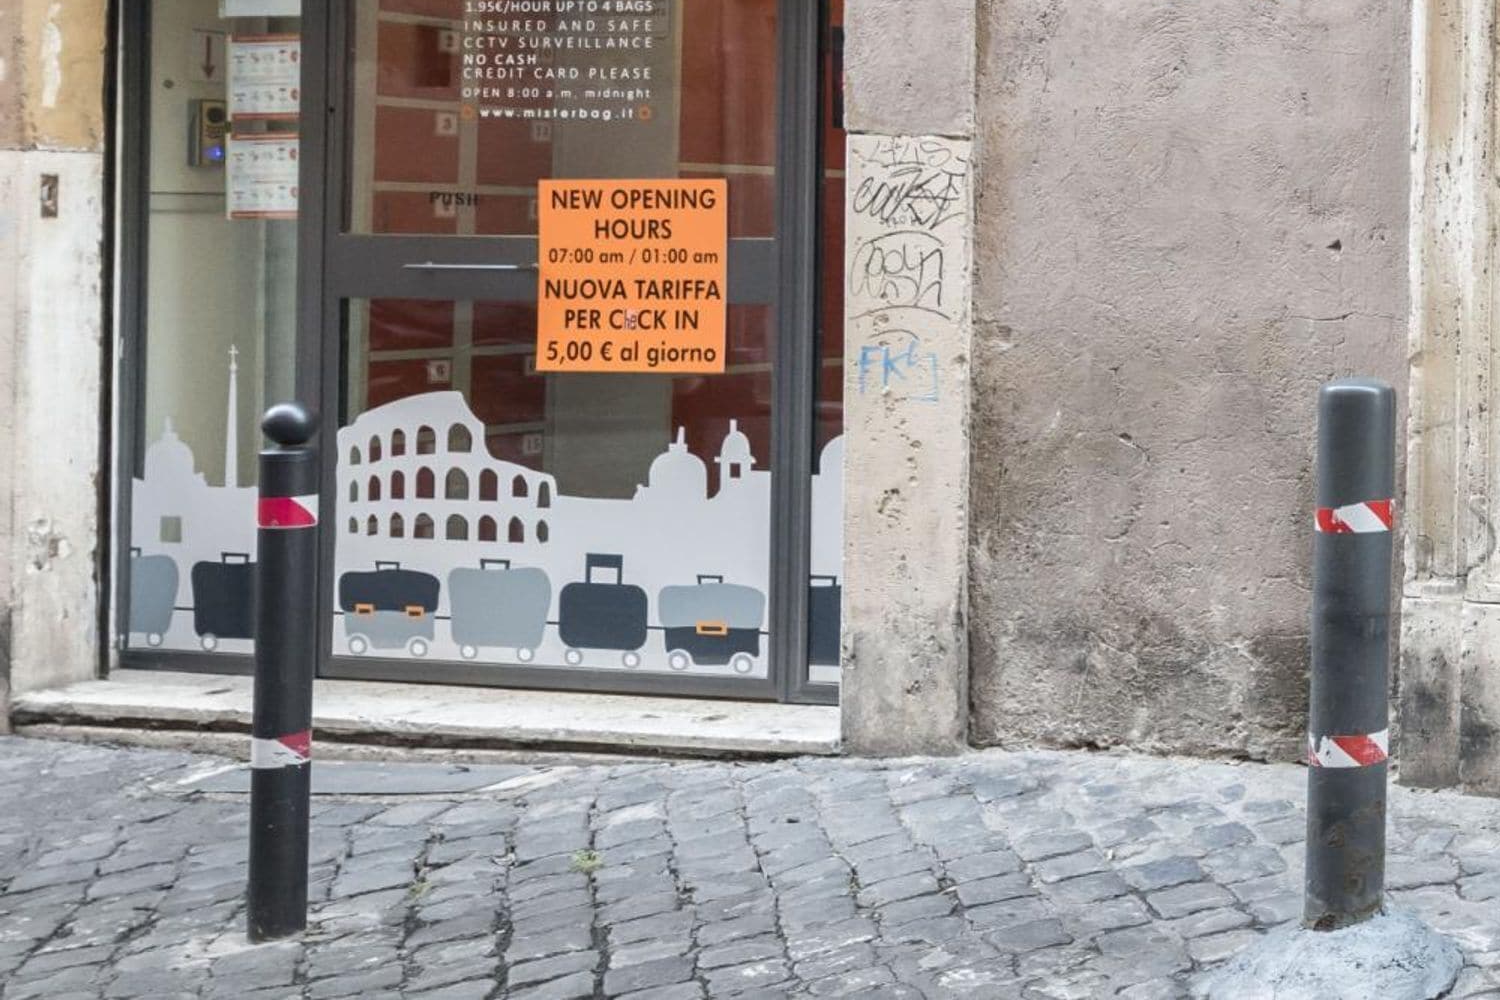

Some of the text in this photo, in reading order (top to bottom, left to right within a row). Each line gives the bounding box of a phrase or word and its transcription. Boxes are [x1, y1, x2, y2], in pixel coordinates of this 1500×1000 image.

[602, 0, 611, 12] 4
[615, 0, 653, 12] BAGS
[463, 19, 653, 32] INSURED AND SAFE
[463, 36, 653, 49] CCTV SURVEILLANCE
[463, 53, 487, 66] NO
[494, 53, 538, 66] CASH
[463, 67, 652, 80] CREDIT CARD PLEASE
[462, 87, 501, 99] OPEN
[507, 87, 540, 99] 8:00
[585, 87, 651, 101] midnight
[479, 107, 635, 121] www.misterbag.it
[429, 191, 479, 206] PUSH
[552, 189, 716, 210] NEW OPENING
[594, 219, 672, 240] HOURS
[548, 248, 719, 265] 07:00 am / 01:00 am
[544, 279, 721, 300] NUOVA TARIFFA
[564, 309, 699, 331] PER CheCK IN
[546, 341, 717, 367] 5,00 € al giorno
